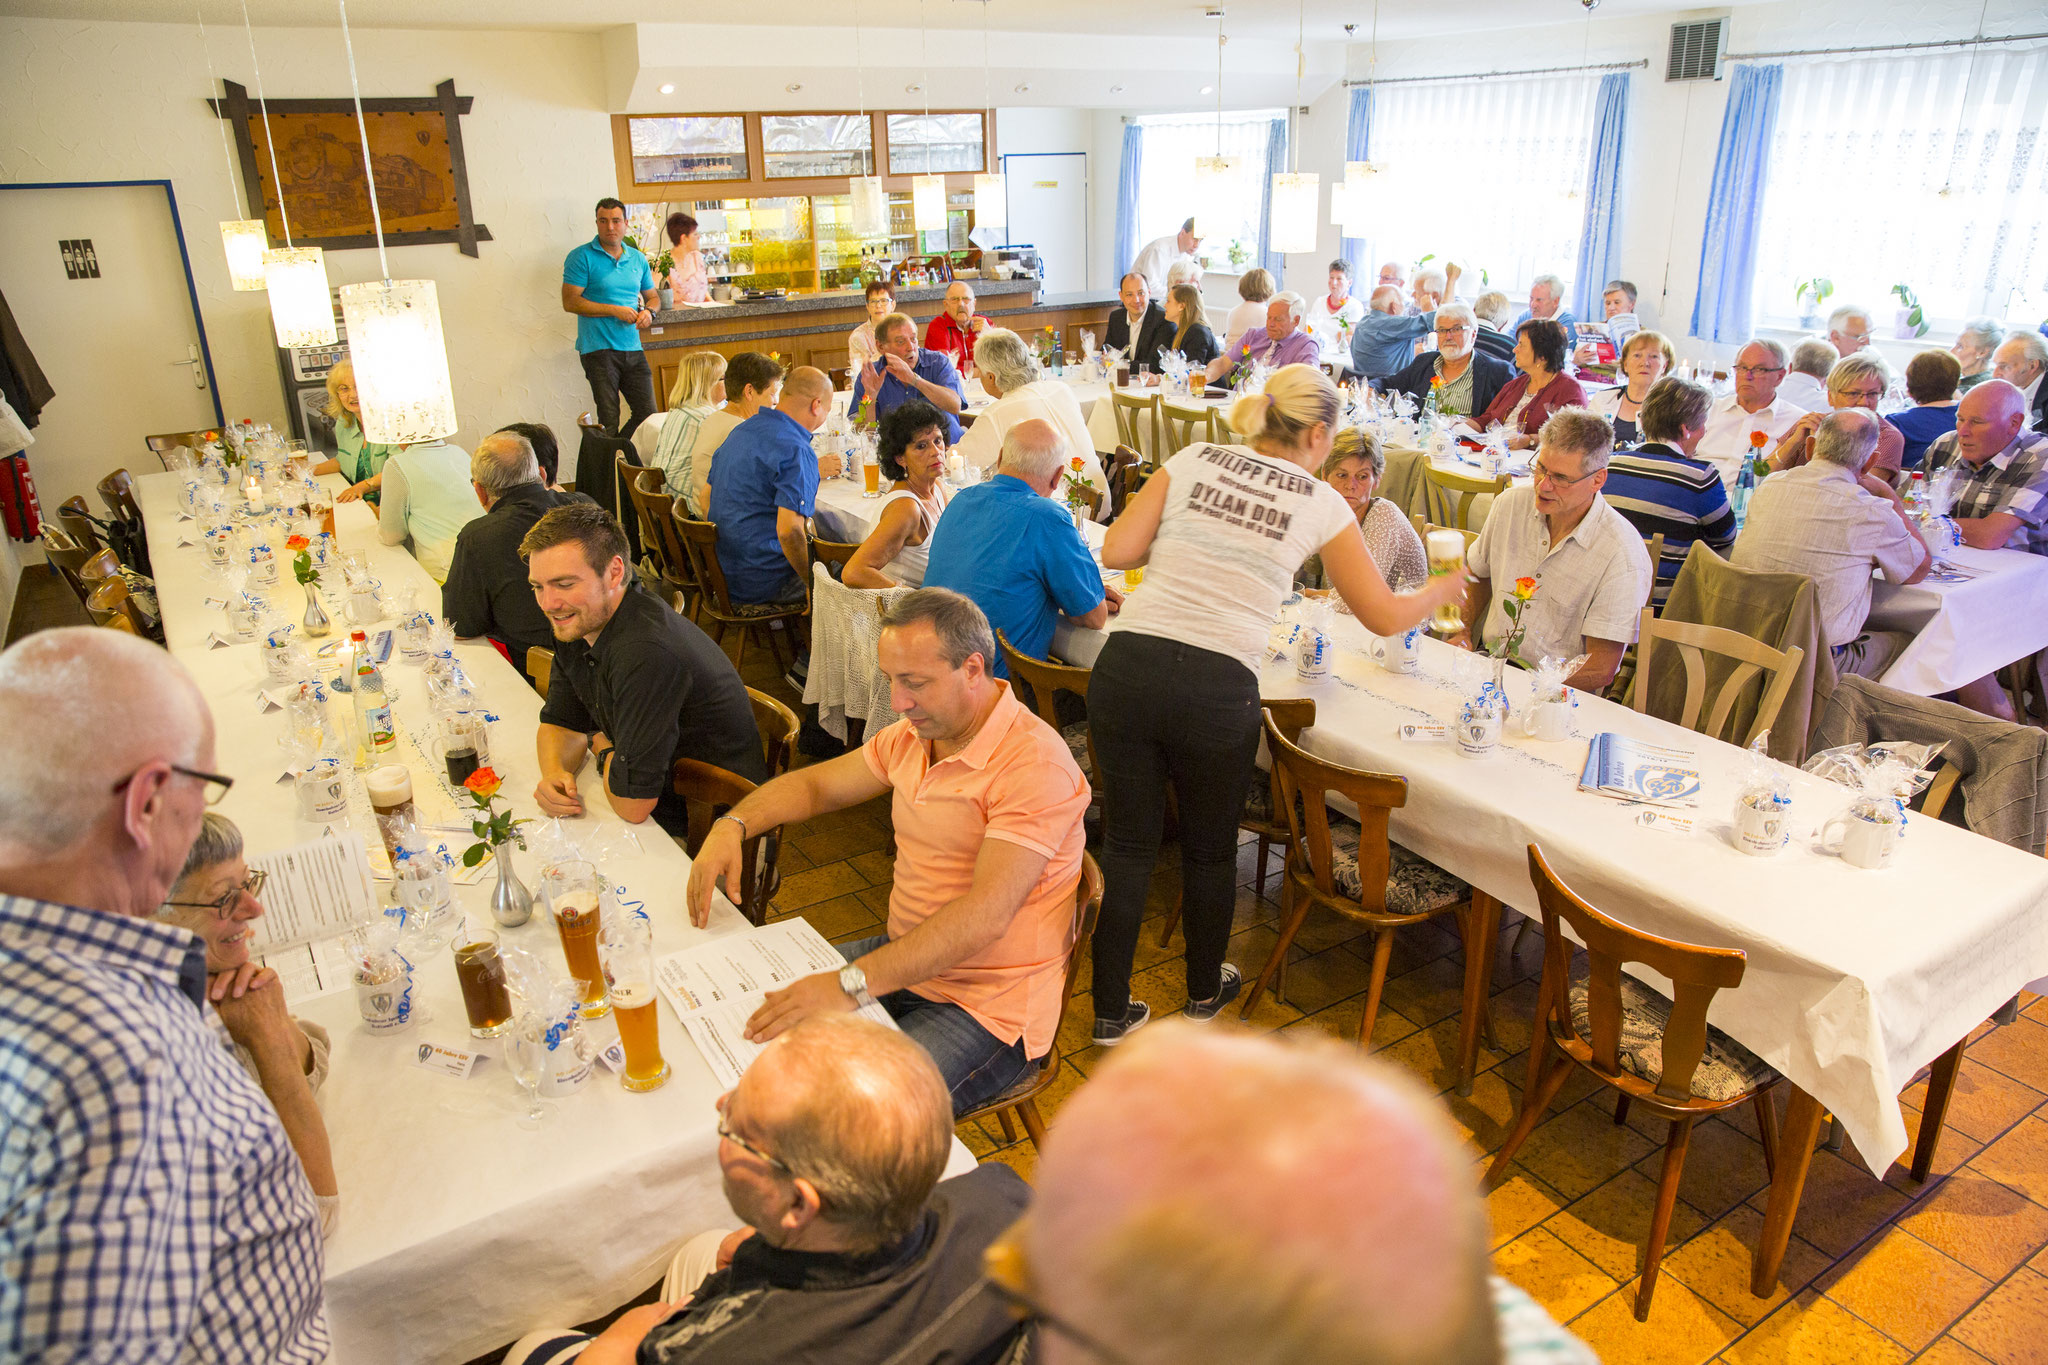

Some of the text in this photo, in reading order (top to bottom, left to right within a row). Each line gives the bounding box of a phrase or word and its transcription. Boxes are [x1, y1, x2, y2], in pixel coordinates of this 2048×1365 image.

[1198, 446, 1314, 497] PHILIPP PLEIN
[1190, 483, 1292, 531] DYLAN DON
